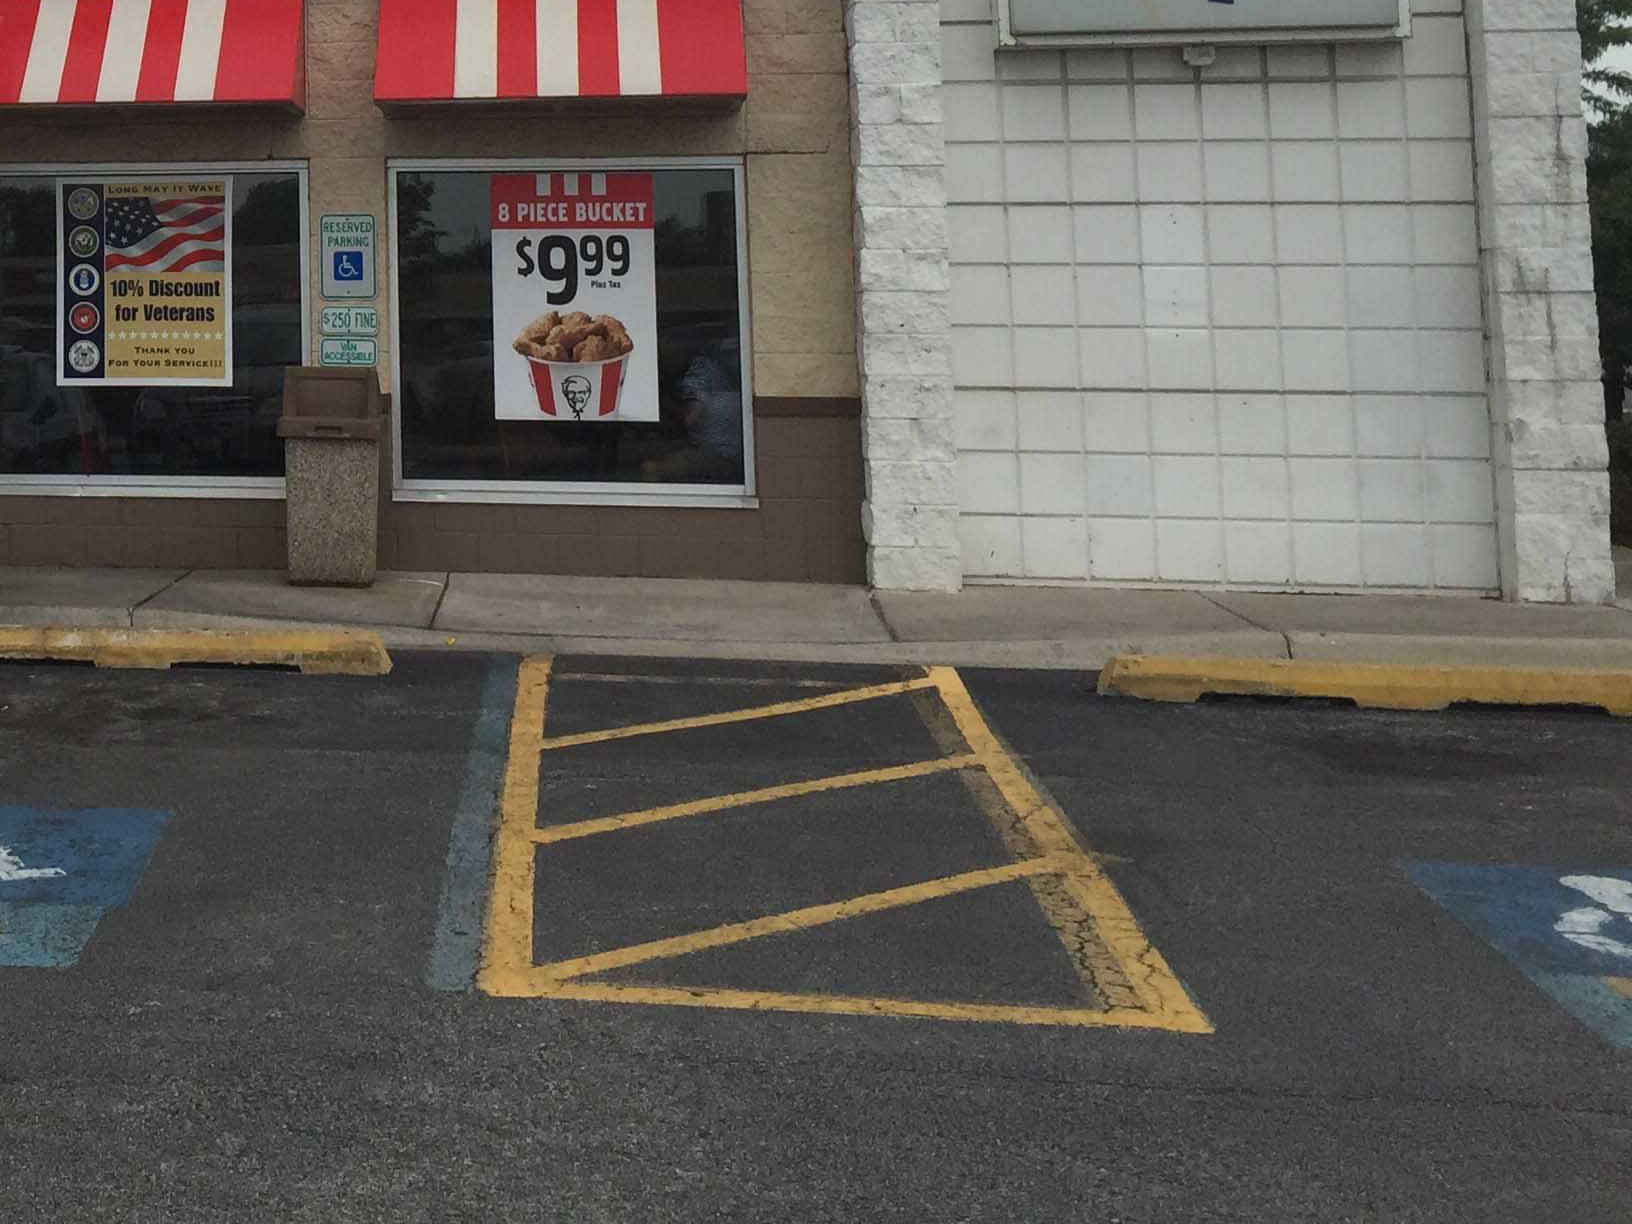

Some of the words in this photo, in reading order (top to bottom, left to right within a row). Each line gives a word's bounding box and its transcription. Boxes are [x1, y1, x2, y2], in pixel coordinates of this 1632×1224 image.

[143, 184, 168, 193] MAY
[188, 184, 222, 193] WAVE
[498, 202, 510, 222] 8
[517, 202, 568, 222] PIECE
[575, 202, 647, 222] BUCKET
[323, 221, 372, 233] RESERVED
[327, 235, 369, 247] PARKING
[110, 279, 144, 297] 10%
[149, 279, 221, 297] Discount
[115, 304, 139, 321] for
[144, 304, 215, 322] Veterans
[354, 312, 377, 328] FINE
[340, 342, 357, 352] VAN
[324, 351, 373, 361] ACCESSIBLE
